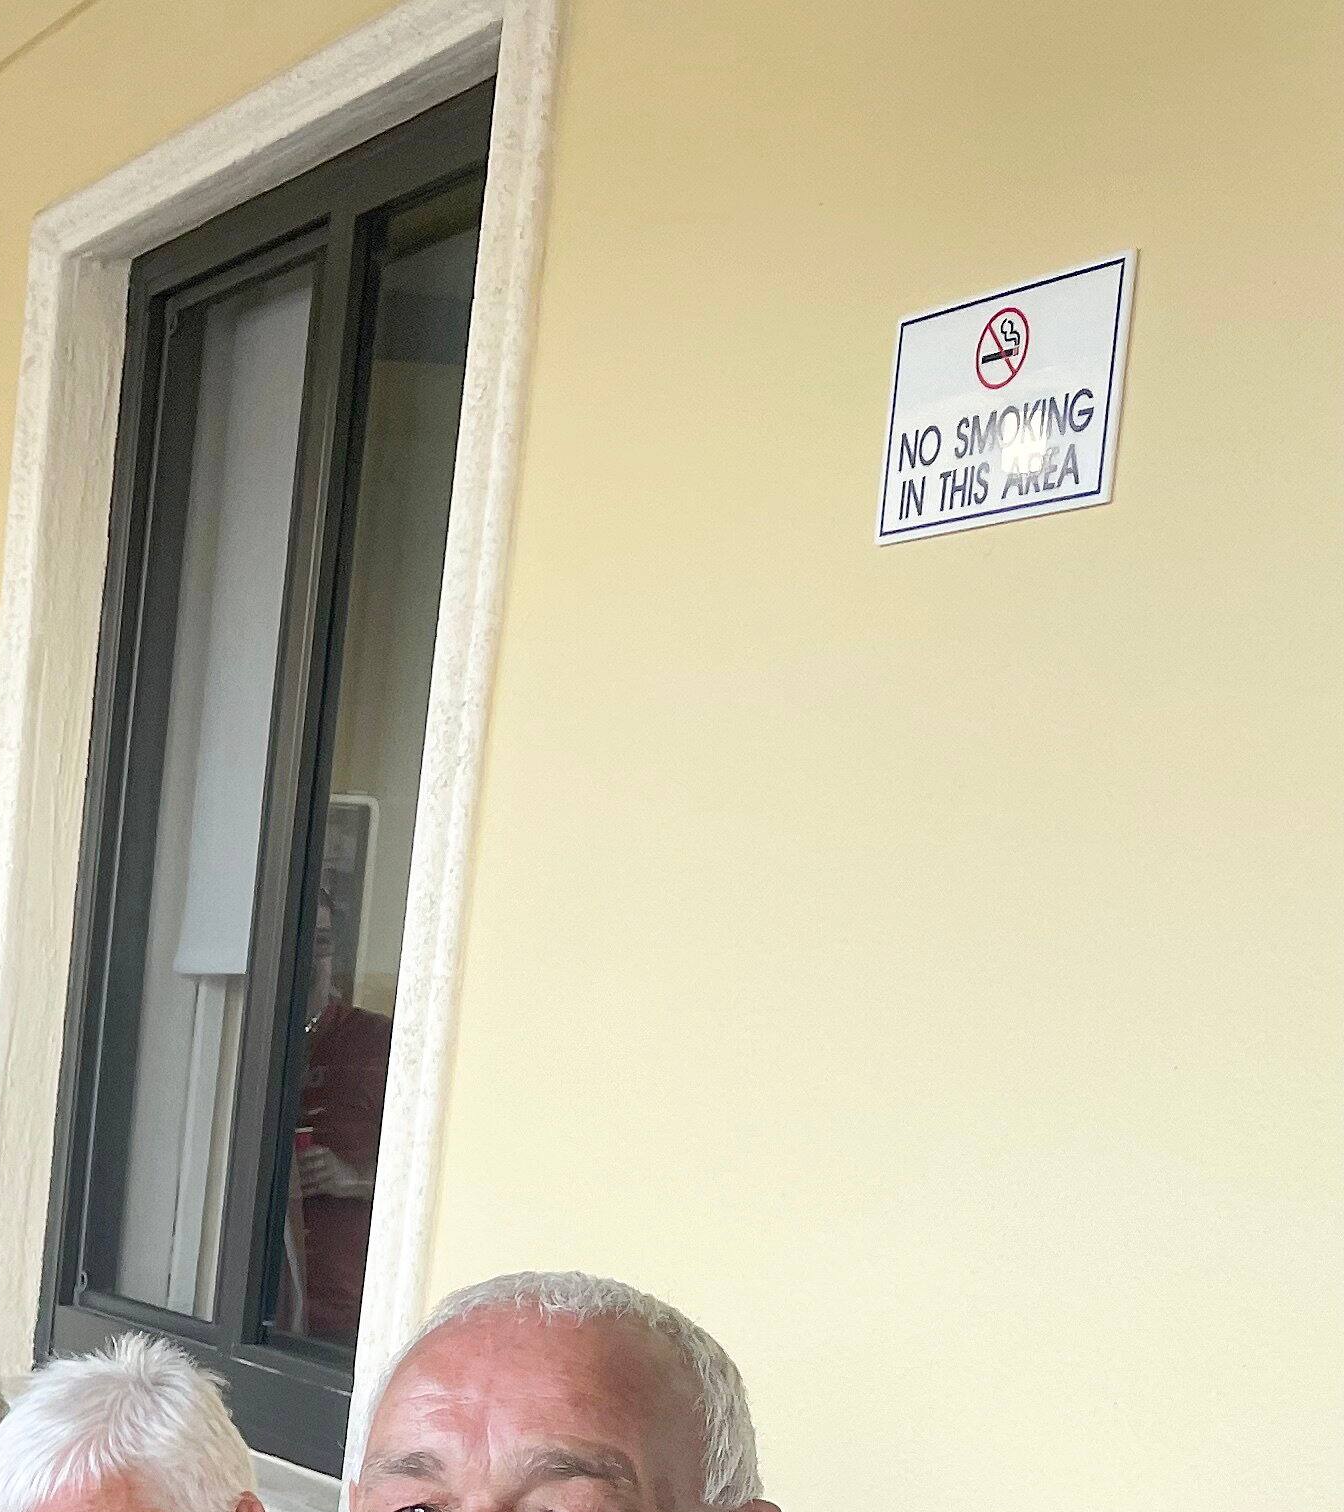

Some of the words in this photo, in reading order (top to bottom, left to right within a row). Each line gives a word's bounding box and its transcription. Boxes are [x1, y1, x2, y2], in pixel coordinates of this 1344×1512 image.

[898, 425, 942, 473] NO
[954, 388, 1094, 459] SMOKING
[898, 475, 927, 521] IN
[938, 461, 991, 512] THIS
[1000, 443, 1081, 500] AREA
